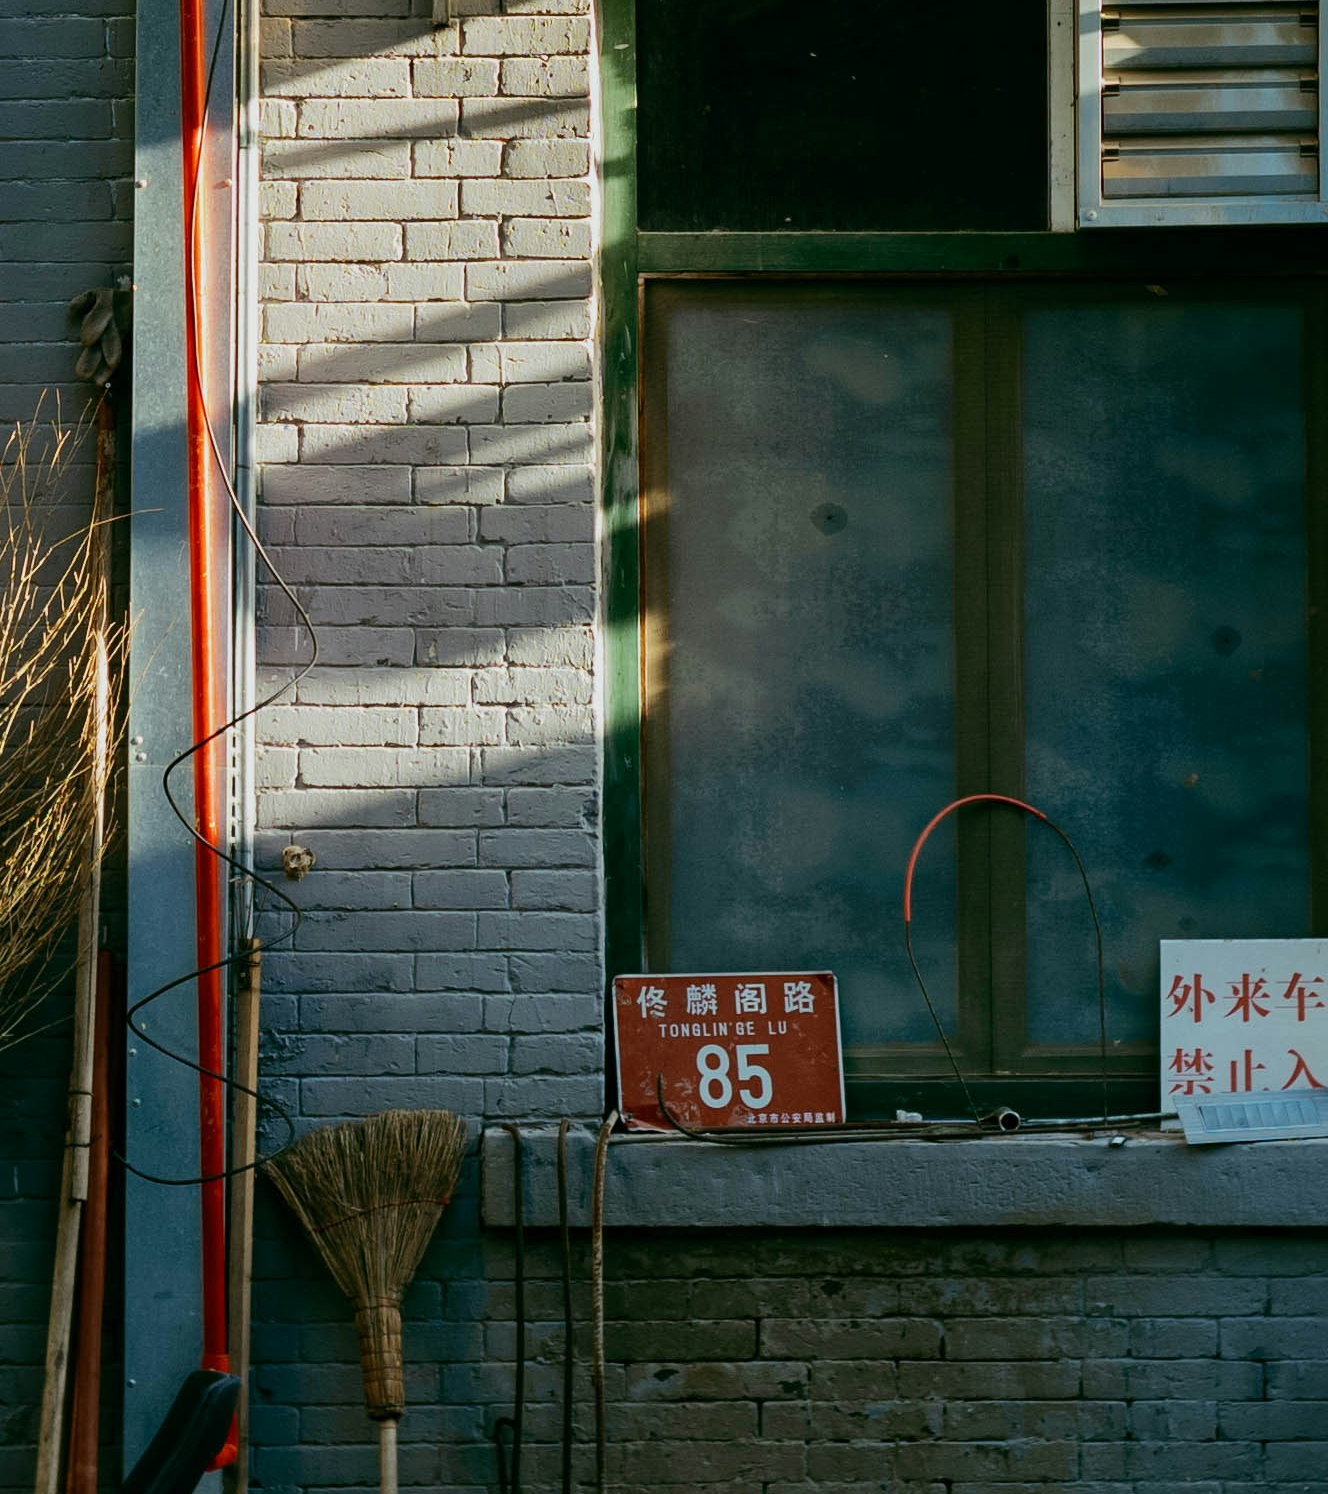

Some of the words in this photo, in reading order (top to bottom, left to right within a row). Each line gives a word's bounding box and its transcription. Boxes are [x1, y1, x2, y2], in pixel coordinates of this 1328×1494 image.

[636, 981, 816, 1018] 佟麟阁路
[768, 1020, 787, 1035] LU
[696, 1043, 773, 1109] 85
